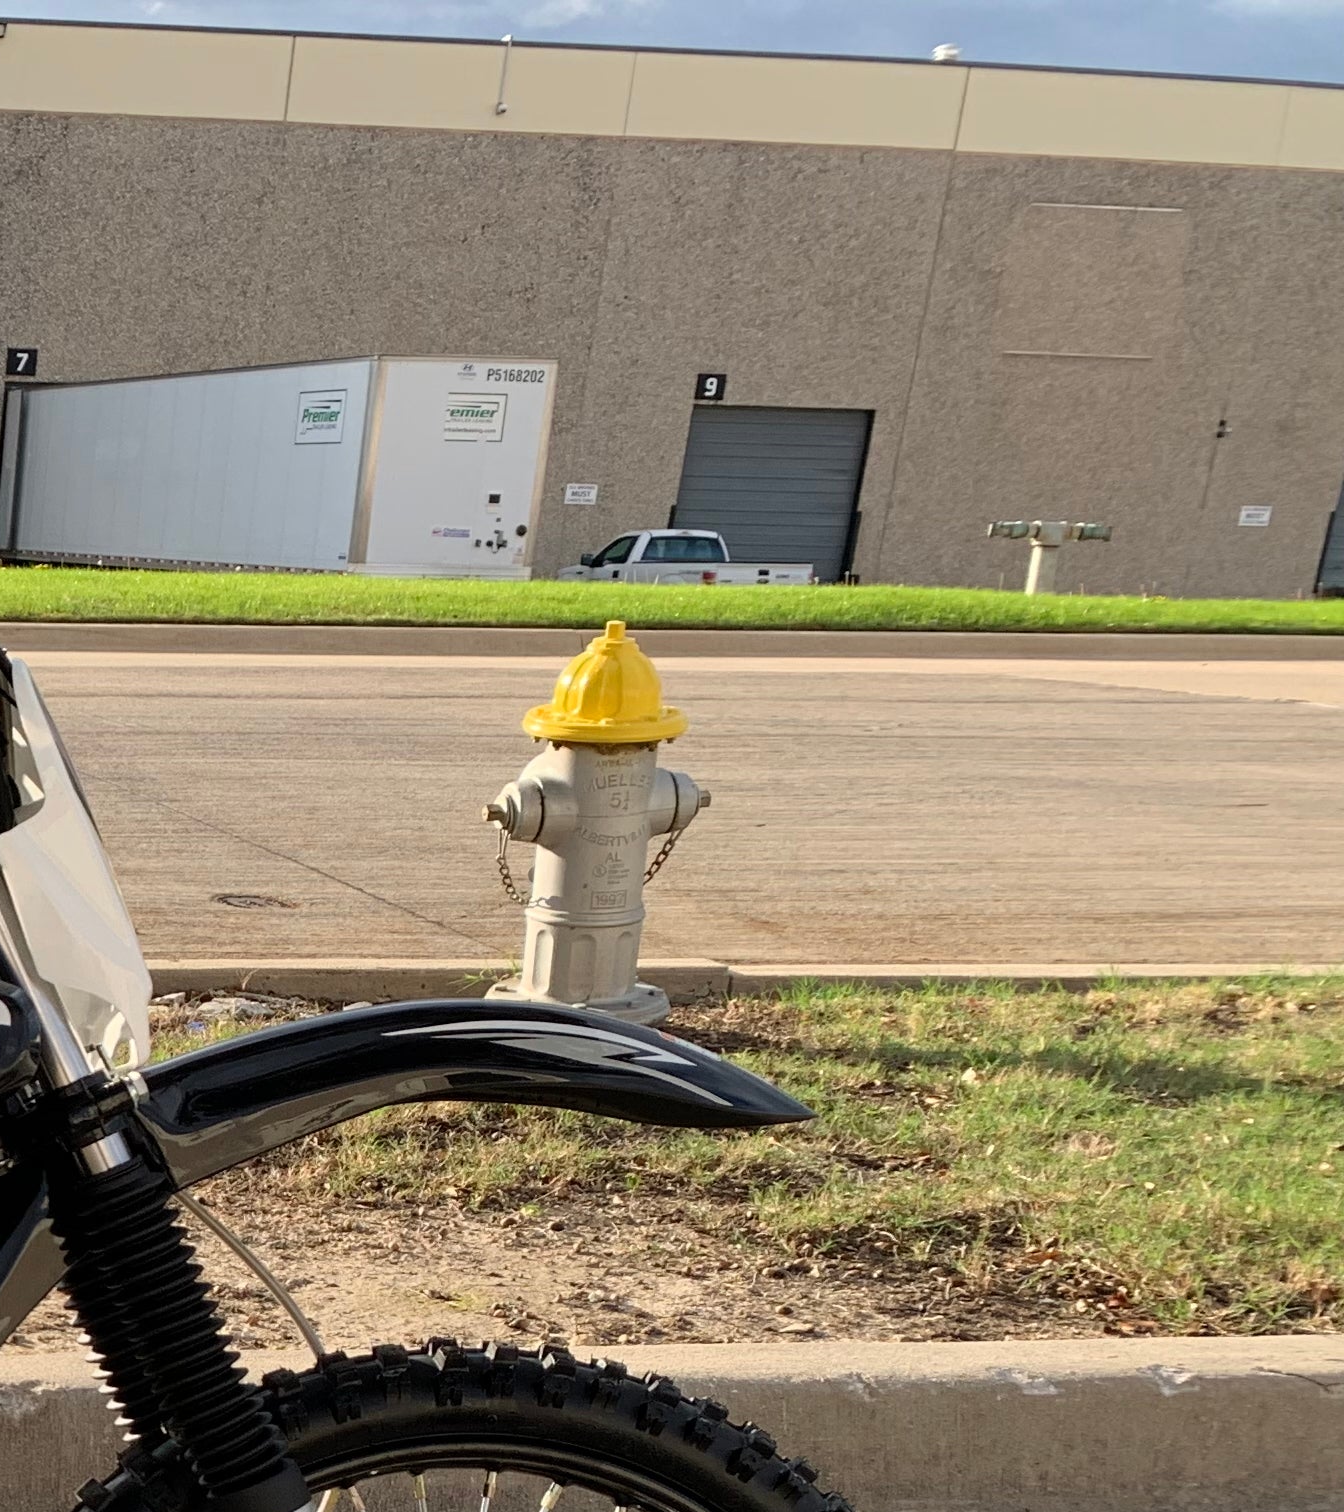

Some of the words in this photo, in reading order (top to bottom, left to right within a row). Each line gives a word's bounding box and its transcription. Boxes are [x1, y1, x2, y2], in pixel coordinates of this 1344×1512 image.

[16, 353, 29, 372] 7
[487, 368, 545, 383] P5168202
[703, 377, 718, 397] 9
[301, 409, 341, 423] Premier
[570, 490, 592, 498] MUST
[605, 851, 622, 864] AL
